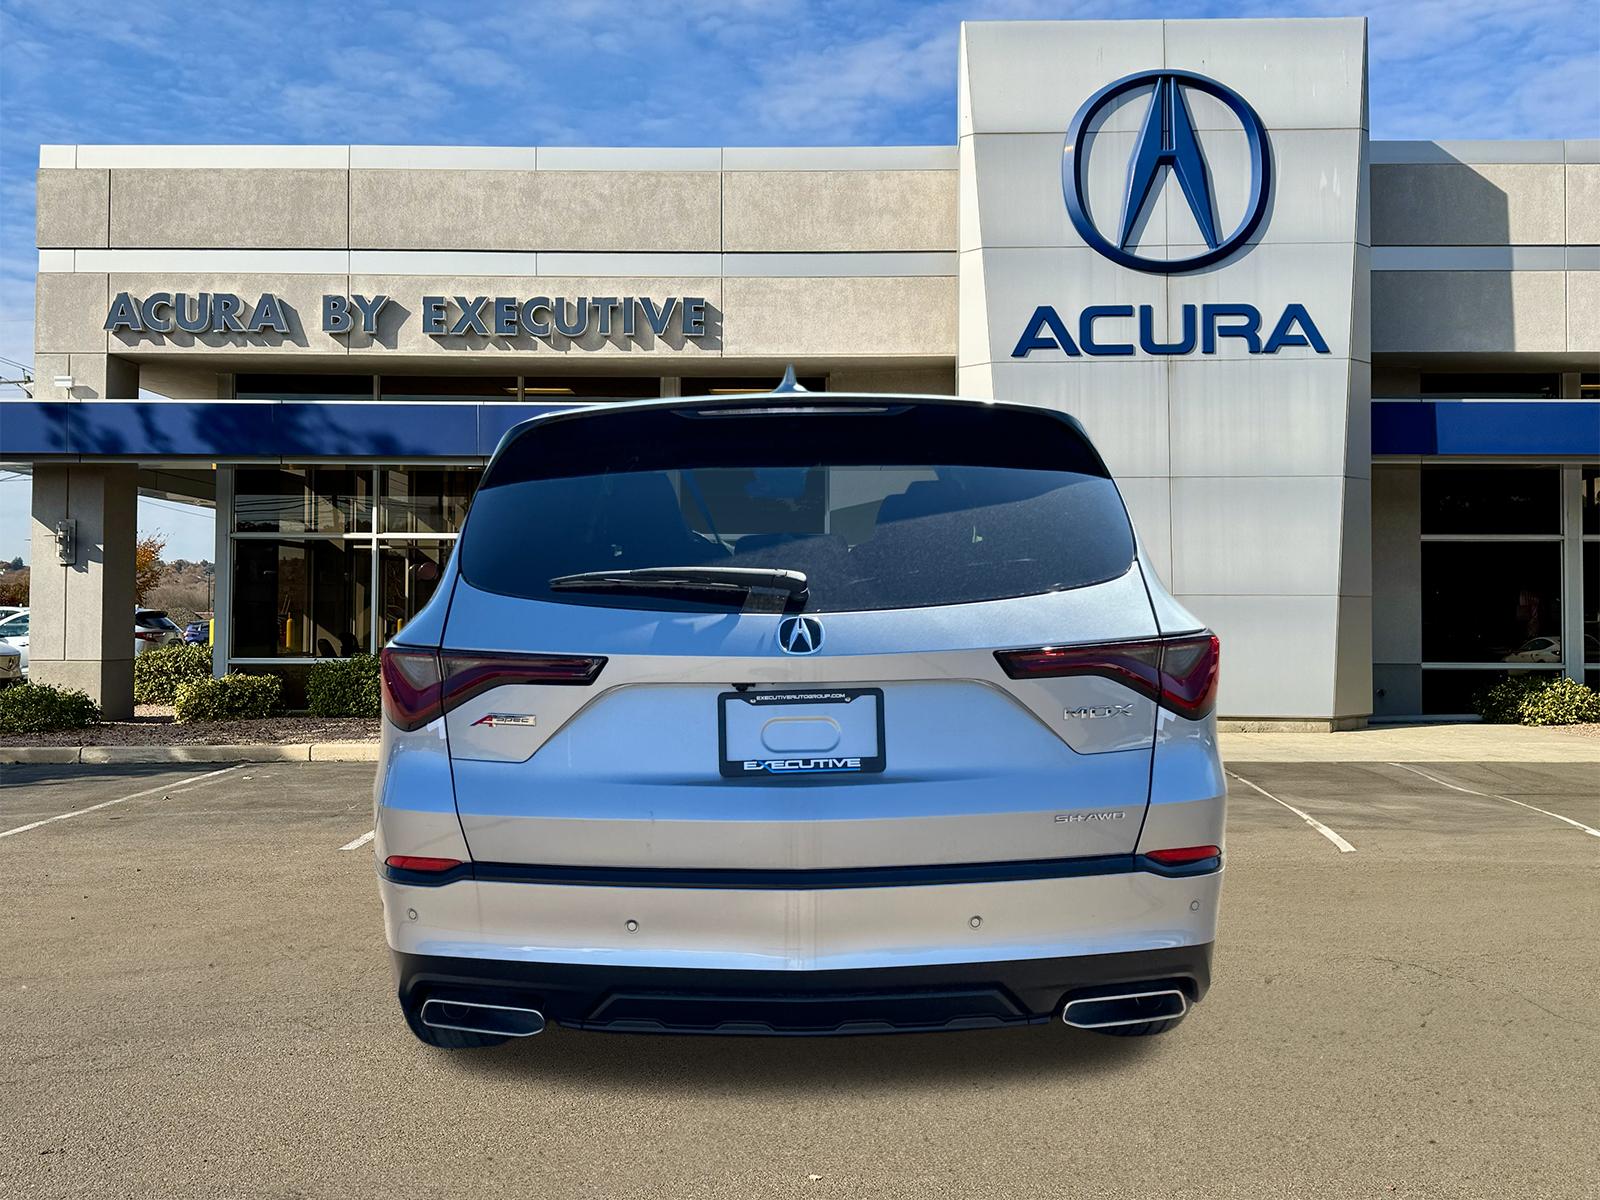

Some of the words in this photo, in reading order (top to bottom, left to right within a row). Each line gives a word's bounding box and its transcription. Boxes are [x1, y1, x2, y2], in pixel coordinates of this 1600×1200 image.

[104, 292, 289, 334] ACURA
[321, 295, 390, 334] BY
[421, 296, 707, 337] EXECUTIVE
[1011, 304, 1332, 357] ACURA
[756, 693, 846, 701] EXECUTIVEAUTOGROUP.COM
[1063, 704, 1133, 720] MDX
[743, 758, 861, 771] EXECUTIVE
